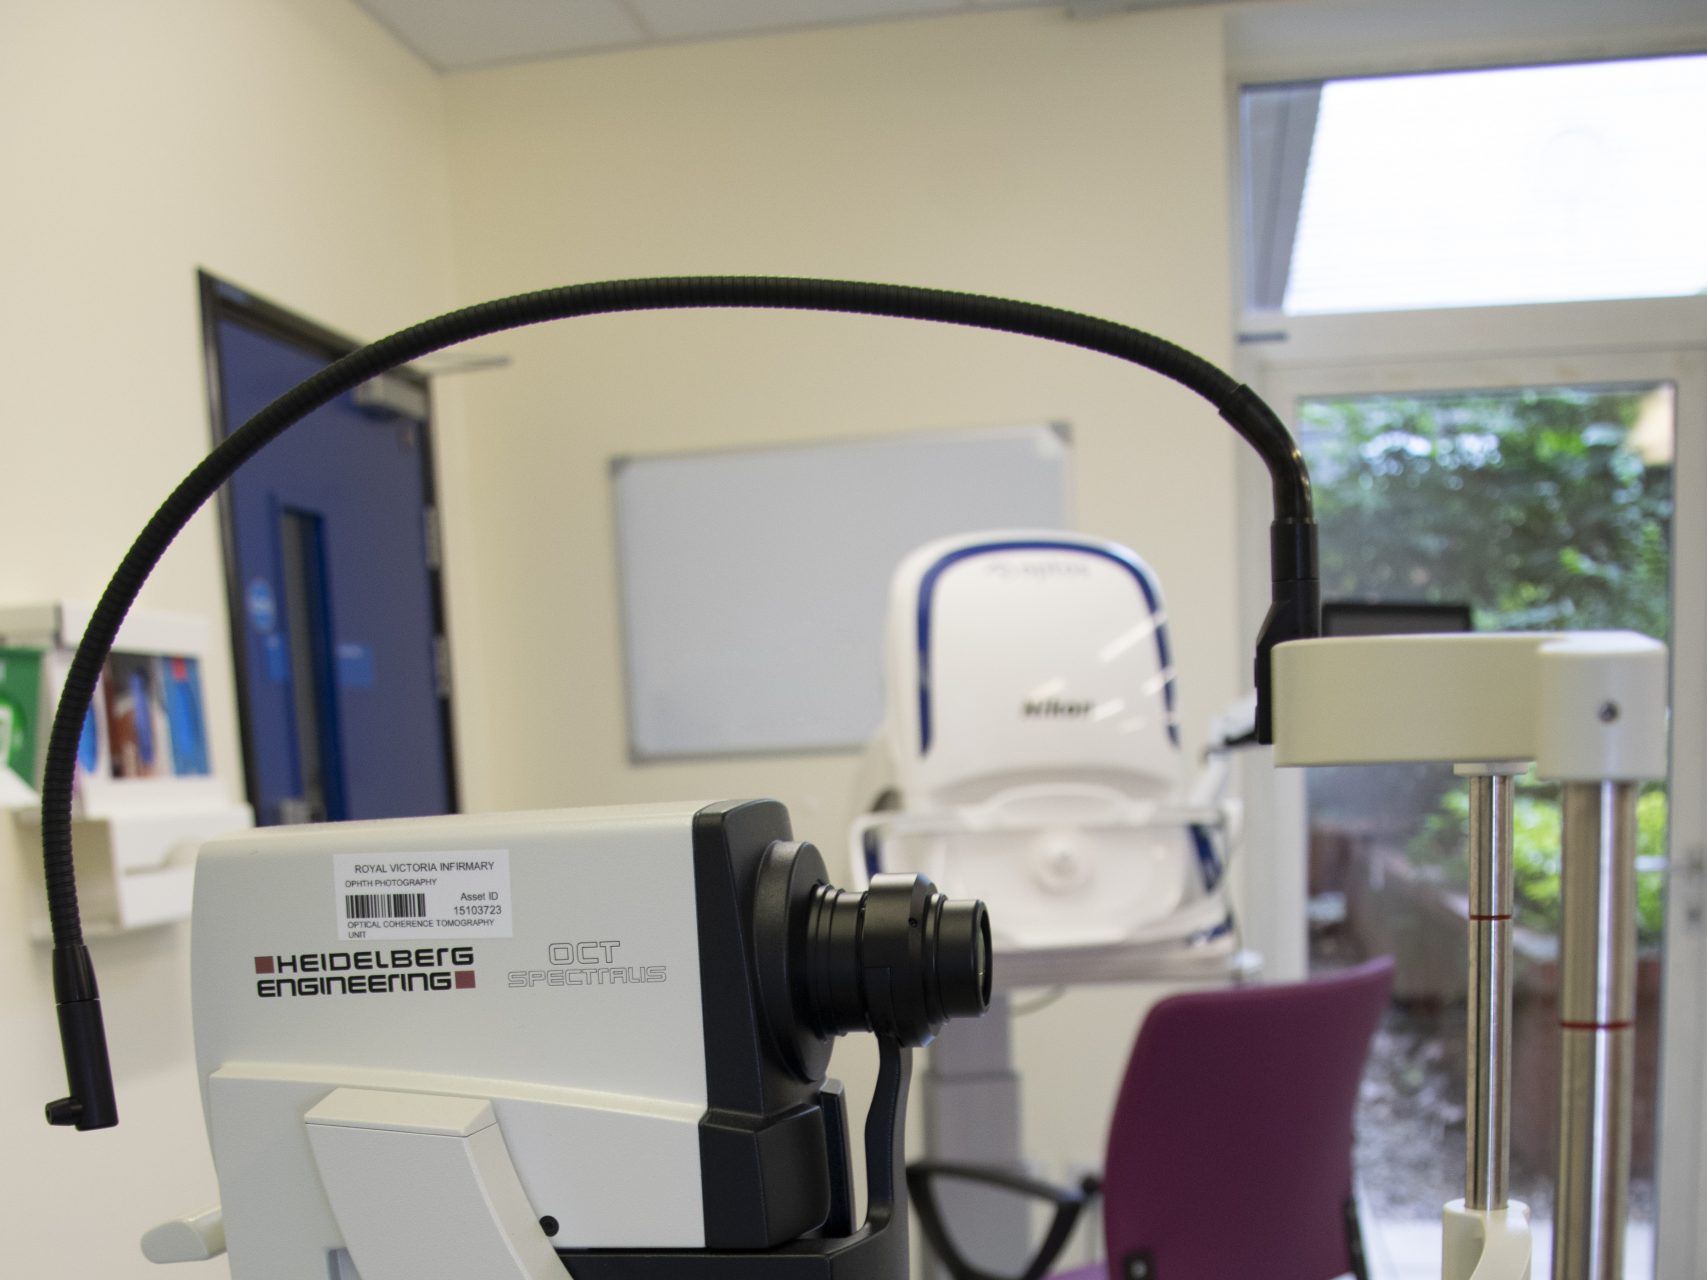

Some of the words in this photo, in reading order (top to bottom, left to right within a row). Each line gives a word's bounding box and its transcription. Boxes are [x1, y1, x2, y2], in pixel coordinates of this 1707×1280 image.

[354, 864, 388, 874] ROYAL
[390, 863, 438, 873] VICTORIA
[440, 861, 495, 871] INFIRMARY
[345, 879, 373, 888] OPHTH
[375, 878, 437, 887] PHOTOGRAPHY
[460, 892, 486, 901] Asset
[488, 891, 499, 900] ID
[454, 904, 502, 915] 15103723
[347, 921, 381, 929] OPTICAL
[383, 920, 434, 928] COHERENCE
[436, 919, 495, 927] TOMOGRAPHY
[548, 940, 621, 965] OCT
[277, 946, 474, 973] HEIDELBERG
[507, 965, 667, 988] SPECTRALIS
[257, 971, 452, 997] ENGINEERING
